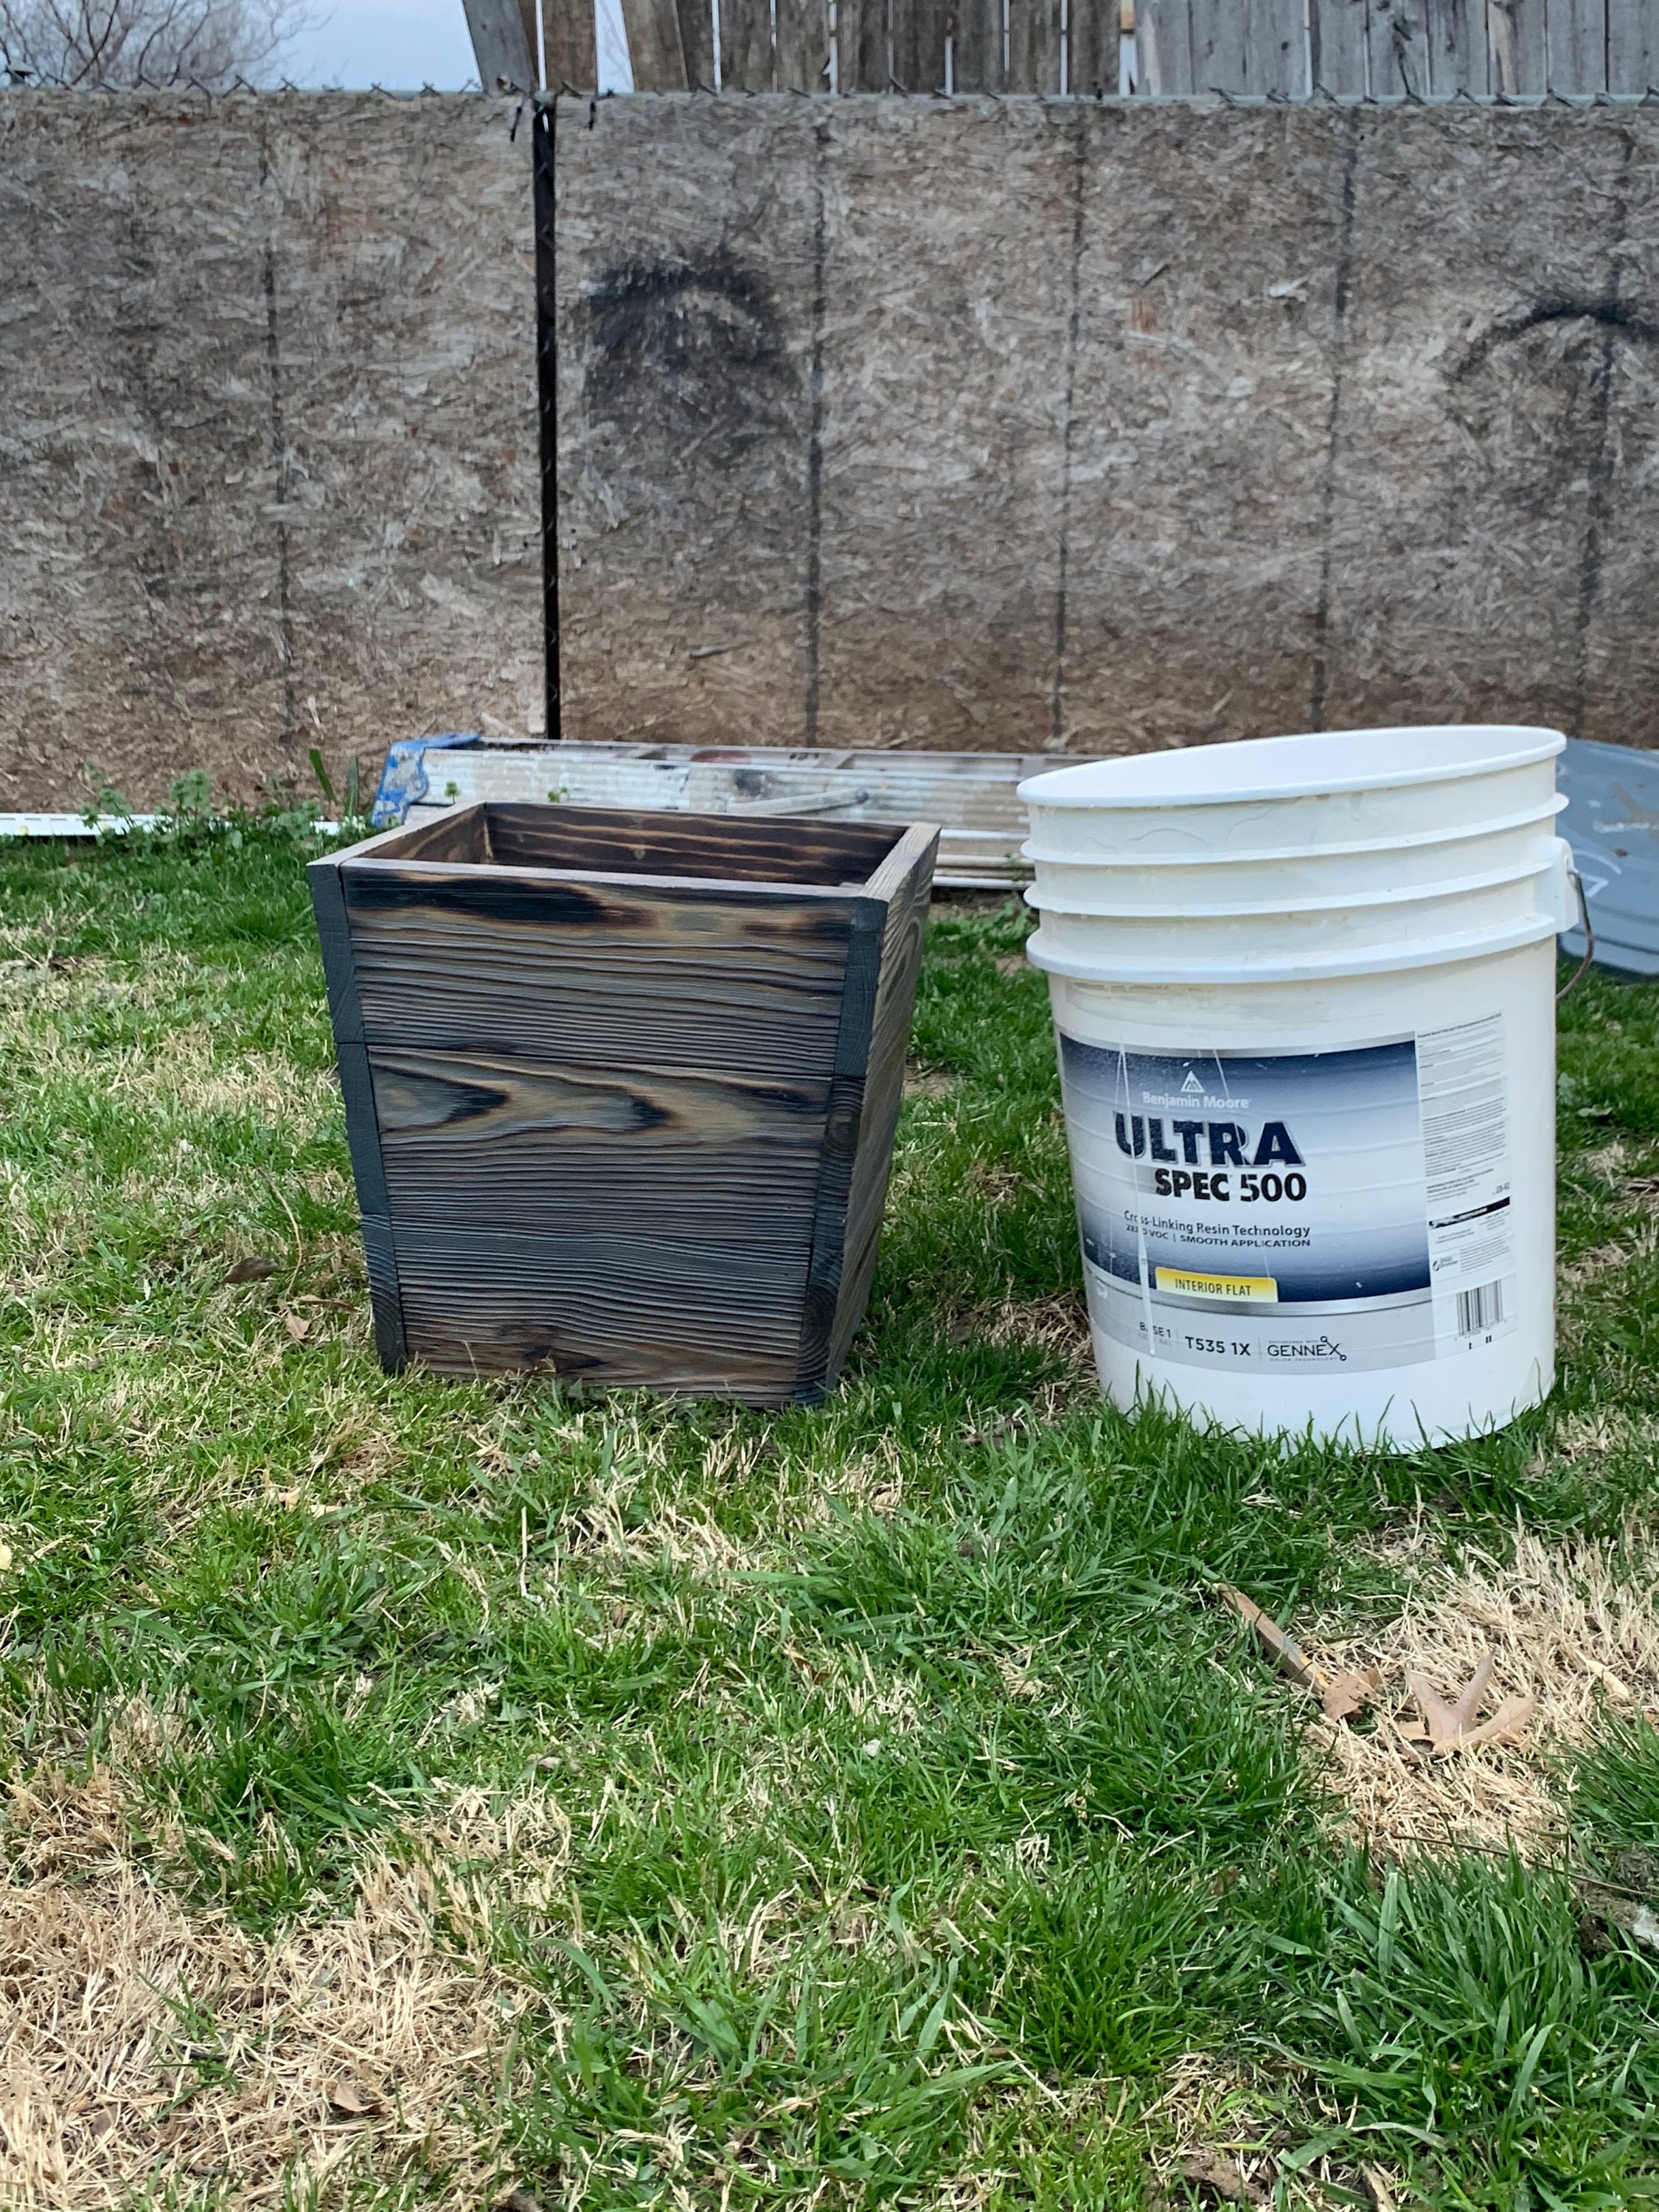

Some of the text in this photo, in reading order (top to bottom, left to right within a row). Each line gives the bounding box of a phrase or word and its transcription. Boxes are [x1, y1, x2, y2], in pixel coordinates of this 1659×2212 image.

[1143, 1091, 1250, 1109] Benjamin Moore
[1113, 1110, 1305, 1167] ULTRA
[1155, 1168, 1307, 1203] SPEC 500
[1149, 1229, 1169, 1239] VOC
[1180, 1234, 1228, 1246] SMOOTH
[1231, 1239, 1311, 1248] APPLICATION
[1197, 1222, 1230, 1235] Resin
[1232, 1225, 1311, 1238] Technology
[1175, 1278, 1251, 1296] INTERIOR FLAT
[1139, 1321, 1171, 1338] BSE 1
[1185, 1335, 1225, 1354] T535
[1231, 1342, 1251, 1356] 1X
[1267, 1335, 1347, 1361] GENNEX
